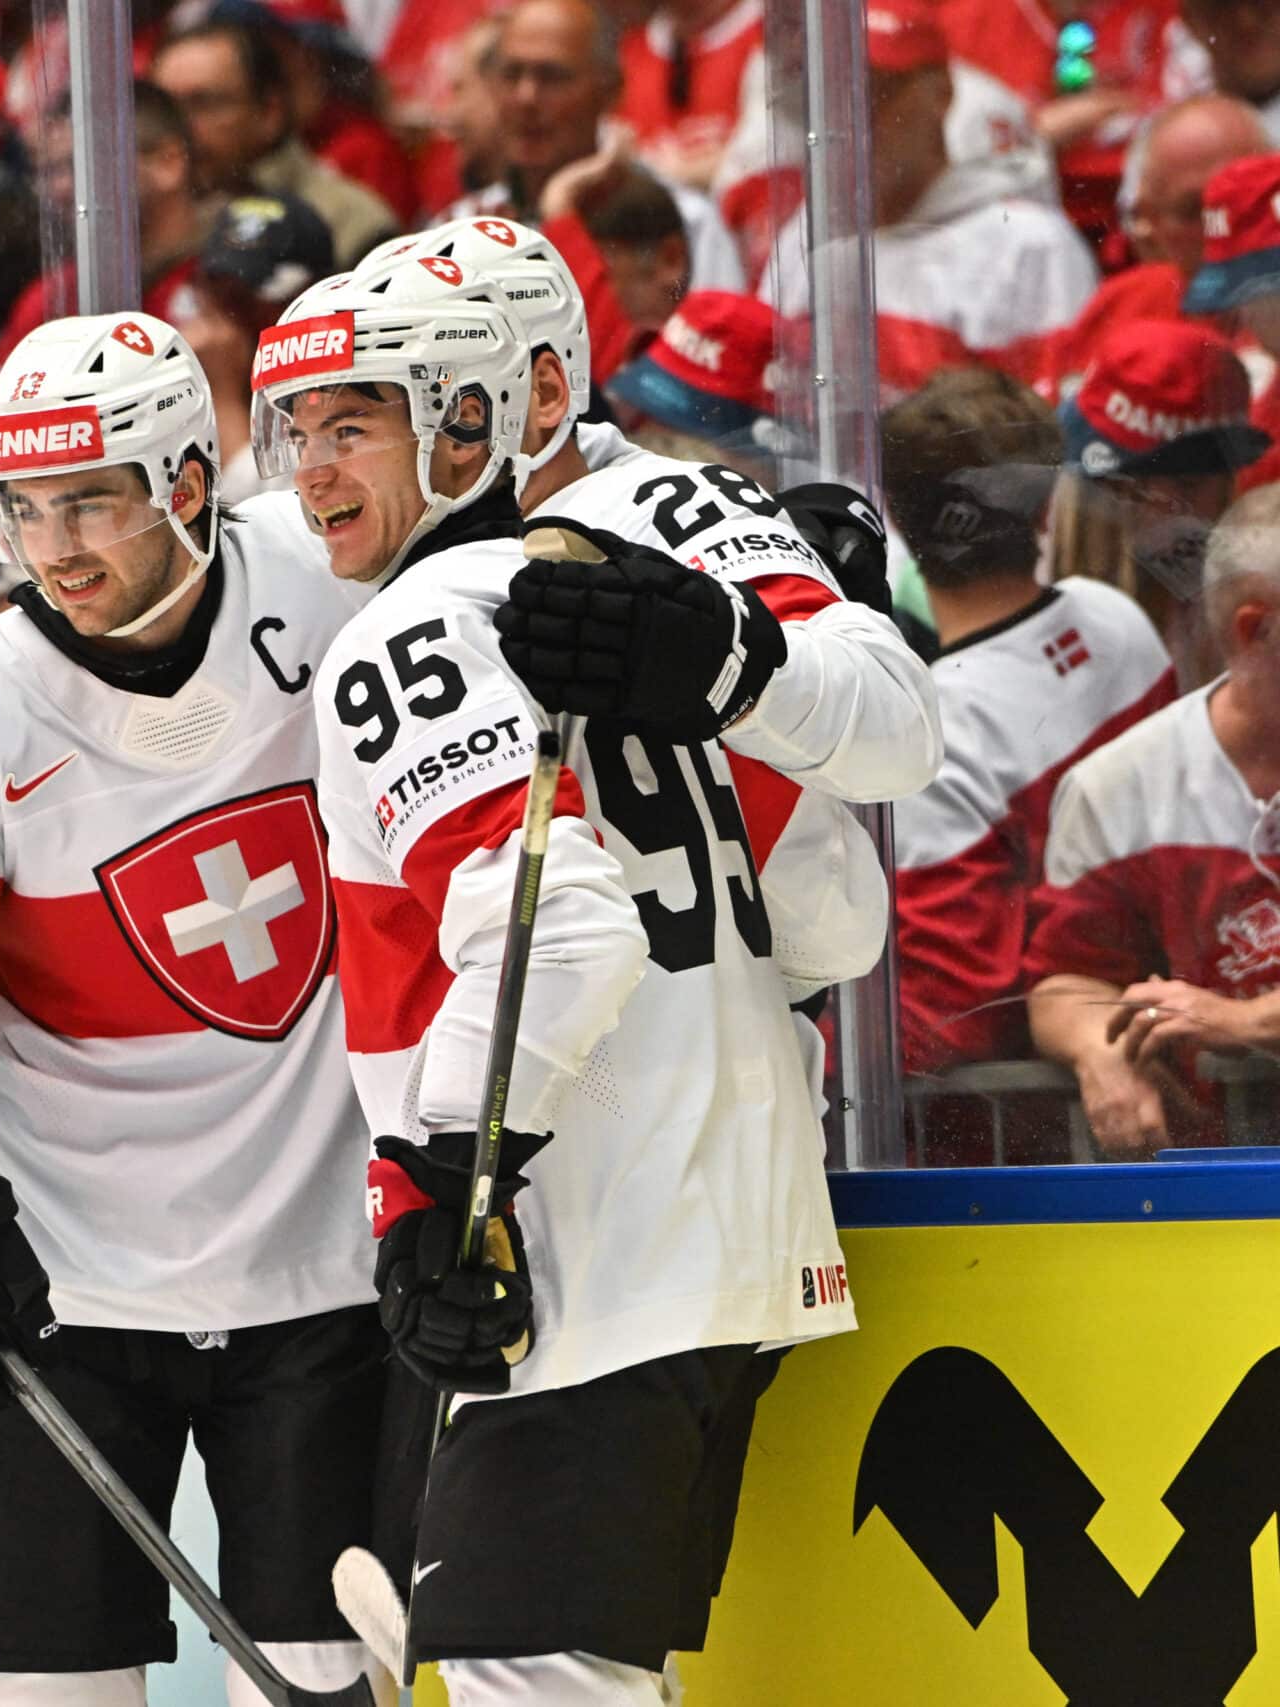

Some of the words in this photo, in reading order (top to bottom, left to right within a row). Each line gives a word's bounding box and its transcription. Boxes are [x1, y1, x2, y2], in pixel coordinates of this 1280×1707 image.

[633, 464, 783, 550] 28
[250, 617, 312, 694] C
[334, 617, 468, 764] 95
[389, 716, 520, 805] TISSOT
[398, 784, 447, 826] WATCHES
[452, 758, 495, 783] SINCE
[502, 742, 536, 761] 1853
[584, 718, 772, 973] 95
[491, 1075, 507, 1119] ALPHA
